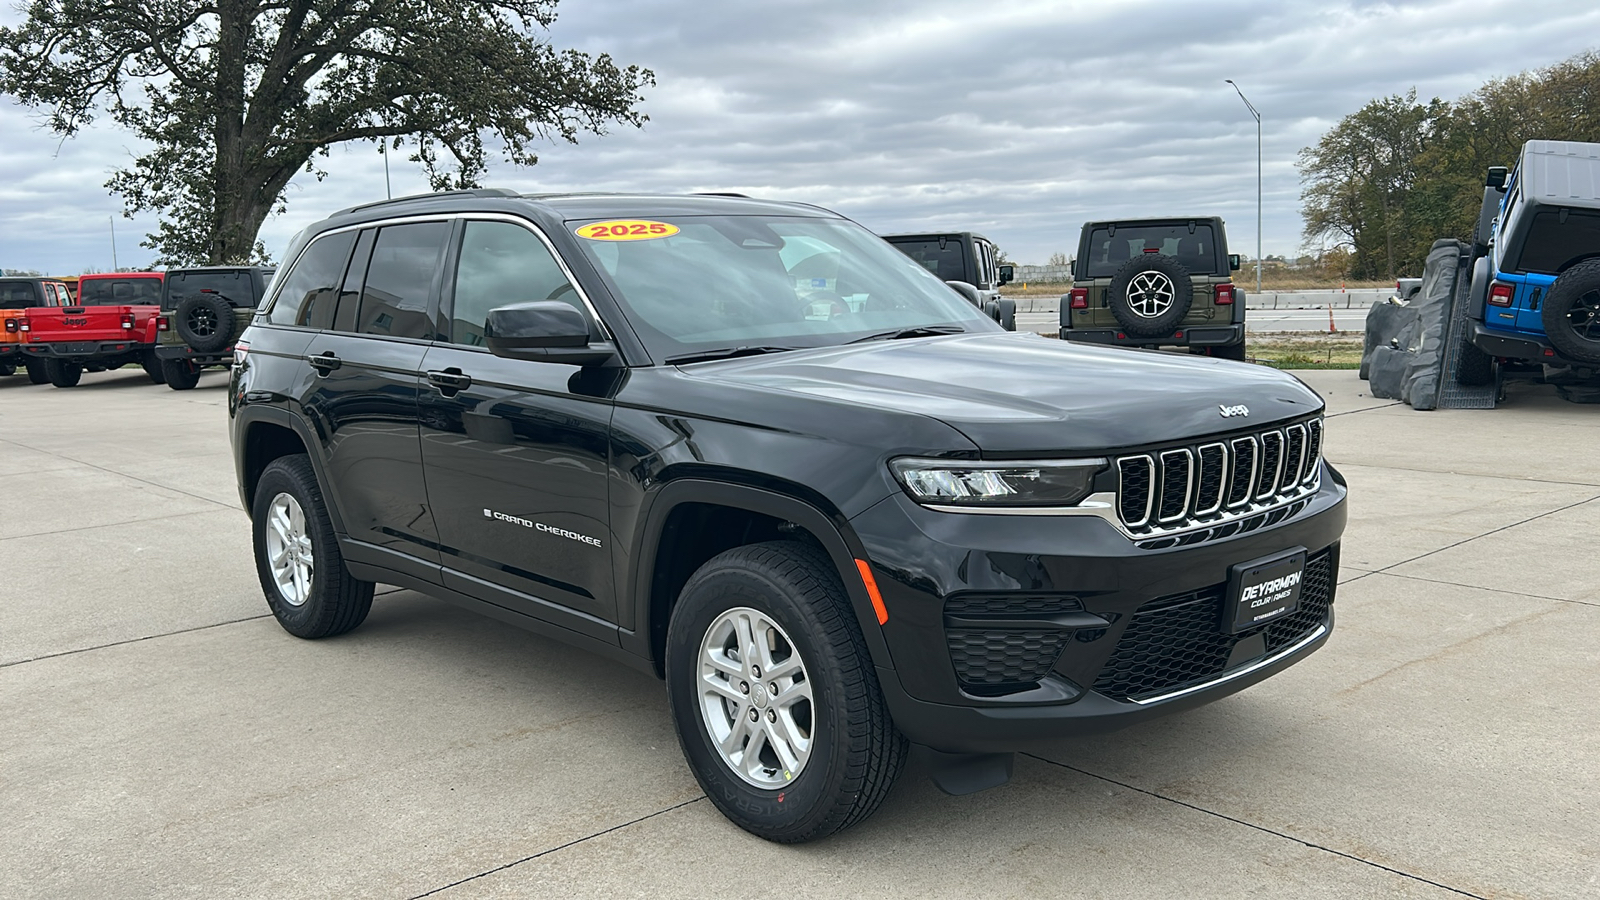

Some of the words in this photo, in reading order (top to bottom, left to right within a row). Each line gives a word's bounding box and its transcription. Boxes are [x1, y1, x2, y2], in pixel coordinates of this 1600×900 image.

[590, 224, 668, 238] 2025
[62, 318, 87, 326] Jeep
[1219, 404, 1249, 417] Jeep
[493, 512, 533, 528] GRAND
[535, 523, 602, 548] CHEROKEE
[1241, 571, 1302, 602] DEYARMAN
